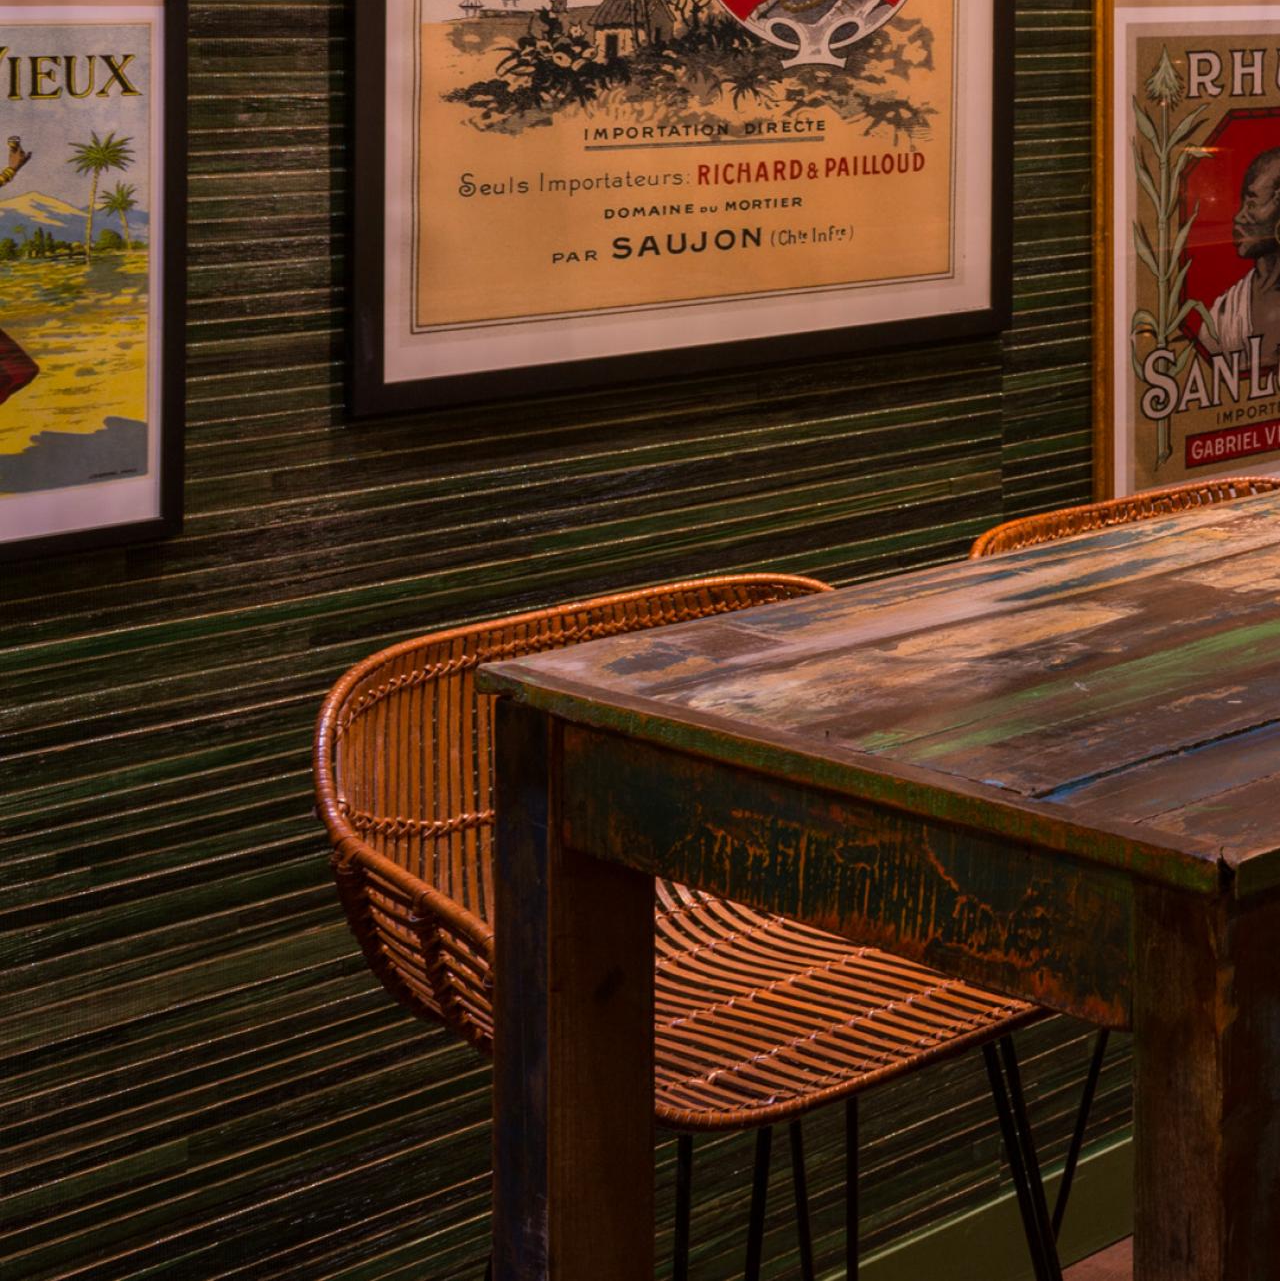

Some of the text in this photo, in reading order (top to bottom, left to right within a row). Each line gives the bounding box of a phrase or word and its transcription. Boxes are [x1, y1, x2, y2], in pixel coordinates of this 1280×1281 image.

[584, 120, 826, 141] IMPORTATION DIRECTE
[458, 172, 530, 198] Seuls
[697, 159, 803, 185] RICHARD
[807, 162, 818, 179] &
[825, 152, 925, 177] PAILLOUD
[604, 204, 694, 220] DOMAINE
[725, 197, 803, 212] MORTIER
[552, 250, 598, 264] PAR
[611, 227, 762, 259] SAUJON
[1191, 432, 1261, 460] GABRIEL
